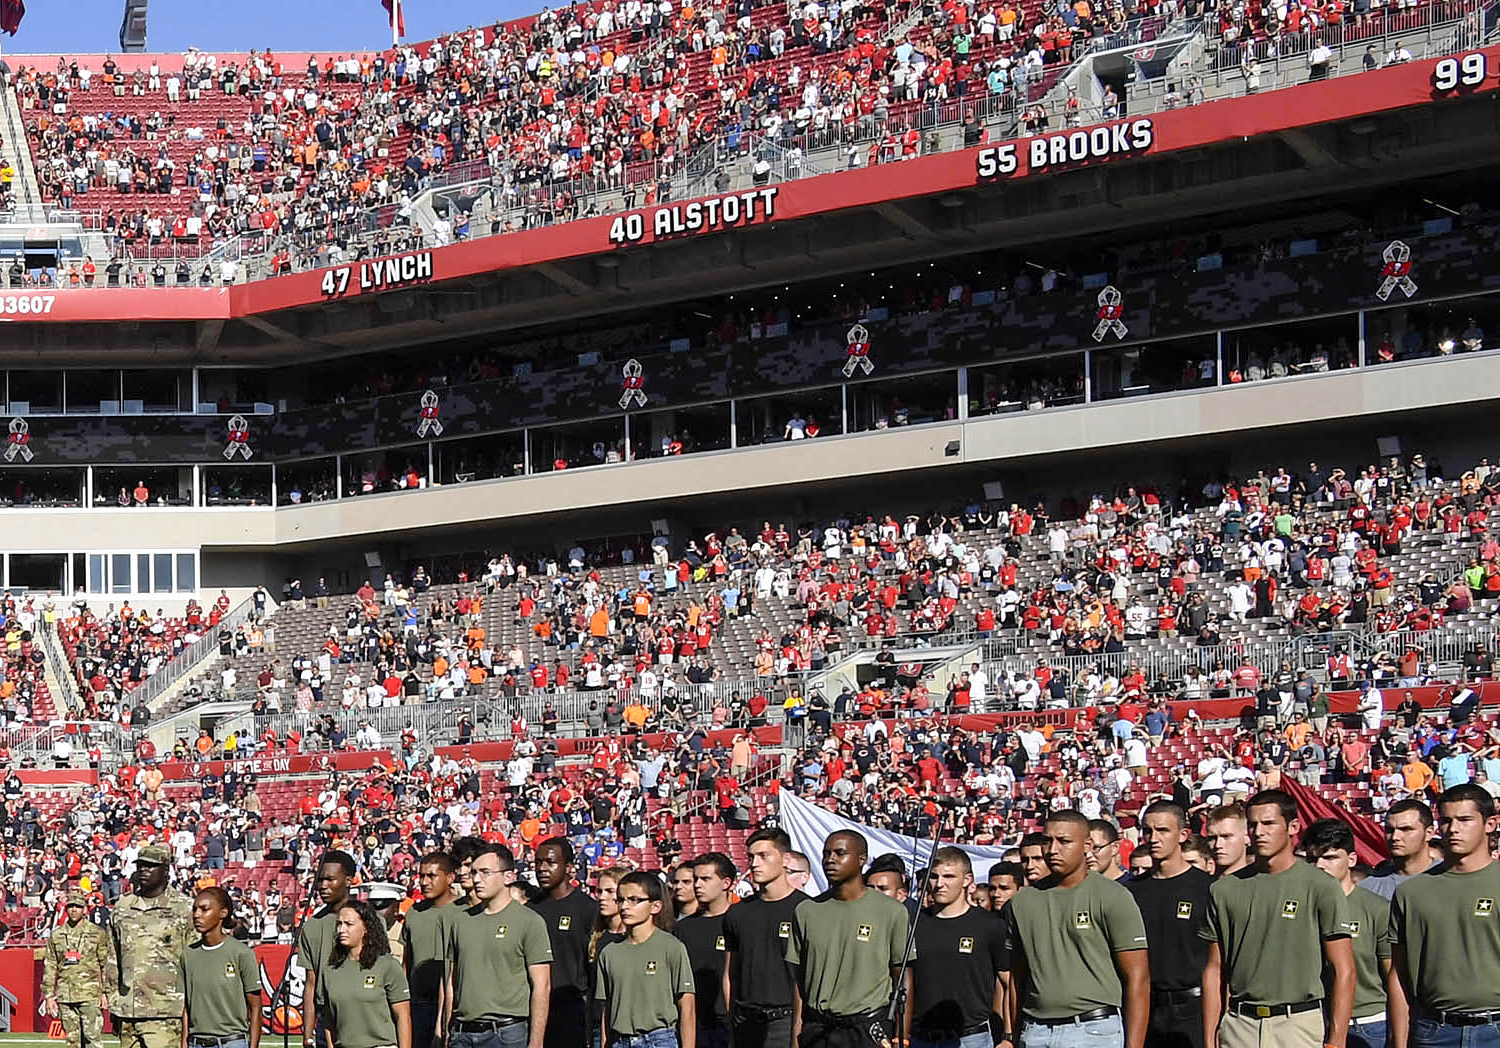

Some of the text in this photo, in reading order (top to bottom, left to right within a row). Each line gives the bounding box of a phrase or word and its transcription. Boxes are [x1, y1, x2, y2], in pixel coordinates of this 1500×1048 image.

[1435, 52, 1485, 91] 99
[977, 119, 1152, 178] 55 BROOKS
[610, 188, 778, 245] 40 ALSTOTT
[322, 252, 432, 296] 47 LYNCH
[274, 759, 290, 771] DAY
